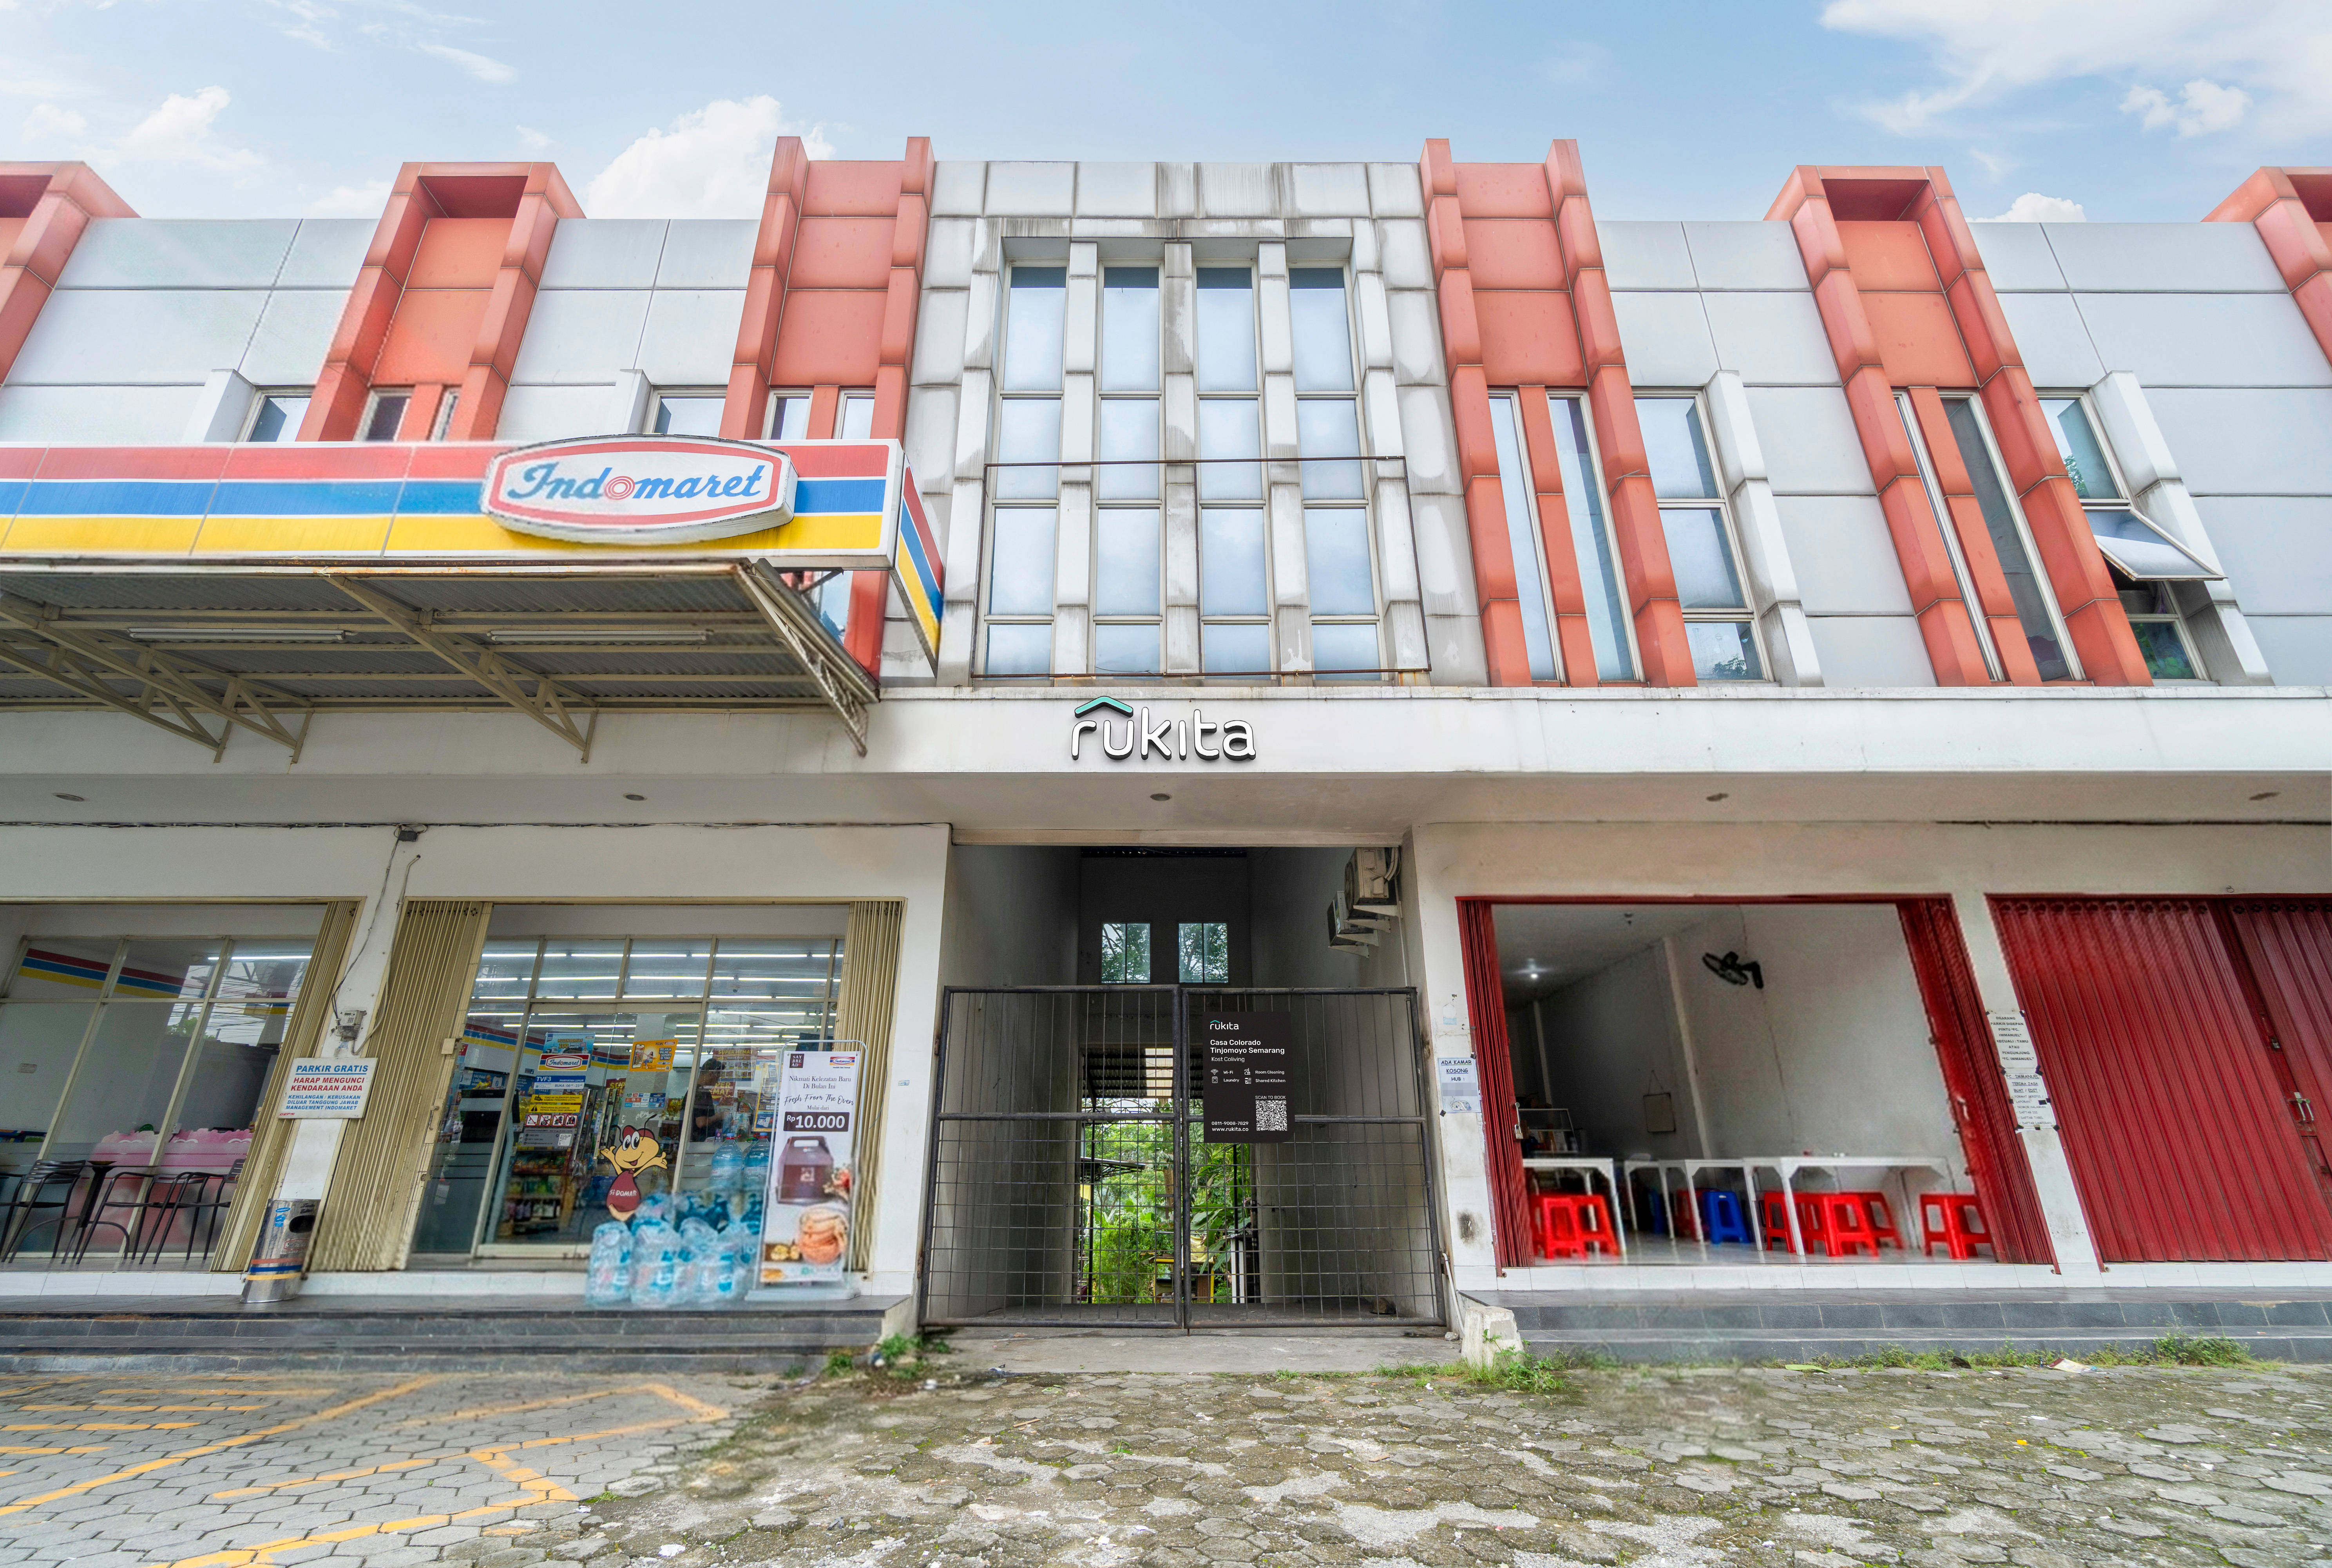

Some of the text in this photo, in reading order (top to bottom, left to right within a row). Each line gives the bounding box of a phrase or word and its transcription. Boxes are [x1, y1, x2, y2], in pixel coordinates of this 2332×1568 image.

[507, 462, 765, 500] Indomaret
[1071, 705, 1256, 761] rukita
[1210, 1021, 1239, 1030] rukita
[784, 1094, 854, 1106] Fresh From The Oven
[787, 1115, 845, 1129] Rp10.000
